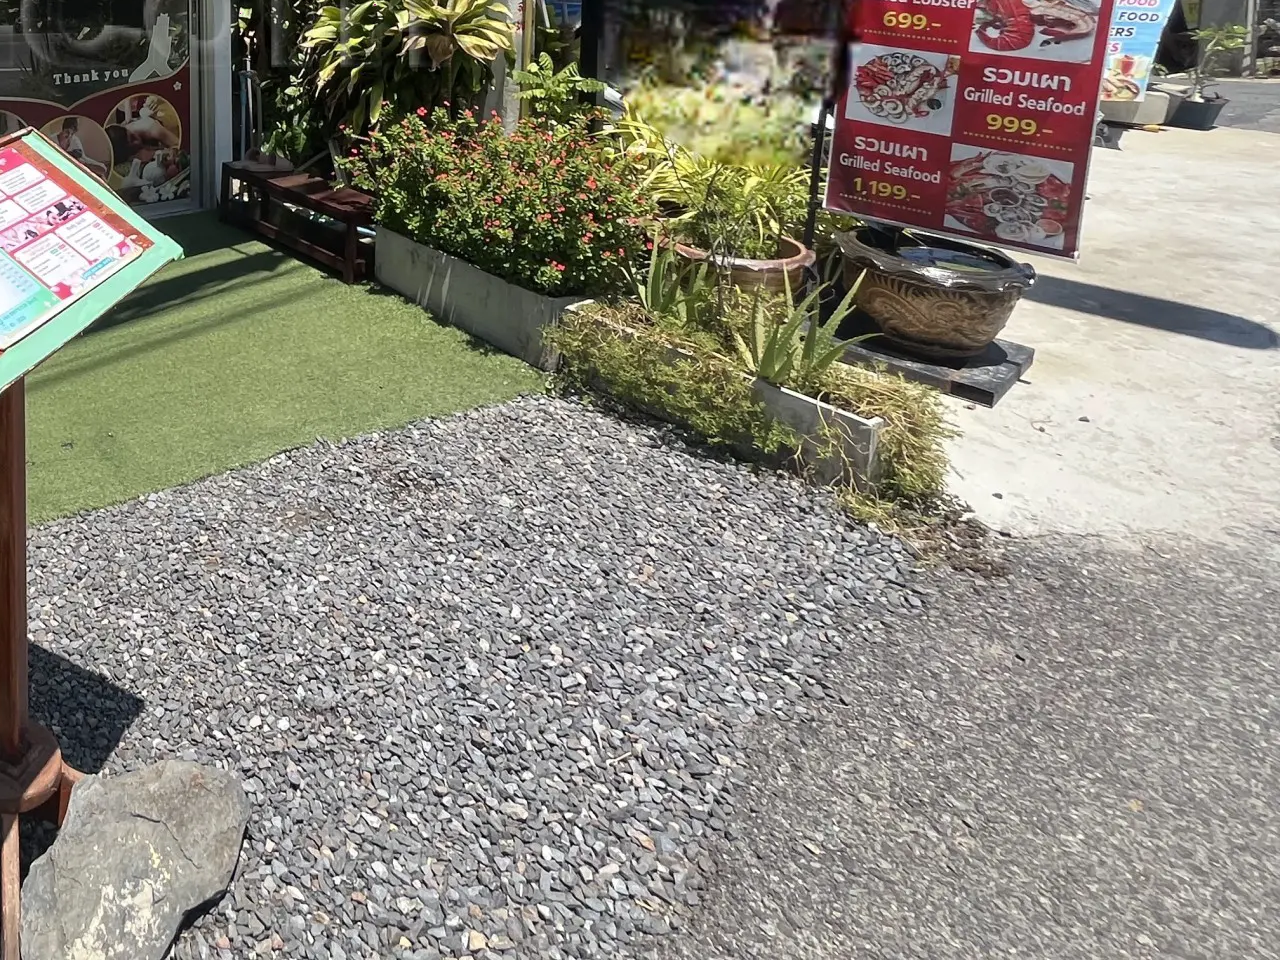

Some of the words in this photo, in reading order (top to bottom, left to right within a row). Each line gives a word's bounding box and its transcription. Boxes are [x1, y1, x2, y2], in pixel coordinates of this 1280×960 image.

[1119, 11, 1160, 22] FOOD
[52, 69, 100, 85] Thank
[104, 68, 129, 82] you
[983, 67, 1072, 92] รวมเผา
[964, 86, 1014, 106] Grilled
[1017, 93, 1086, 116] Seafood
[854, 136, 928, 161] รวมเผา
[840, 153, 880, 172] Grilled
[883, 161, 941, 184] Seafood
